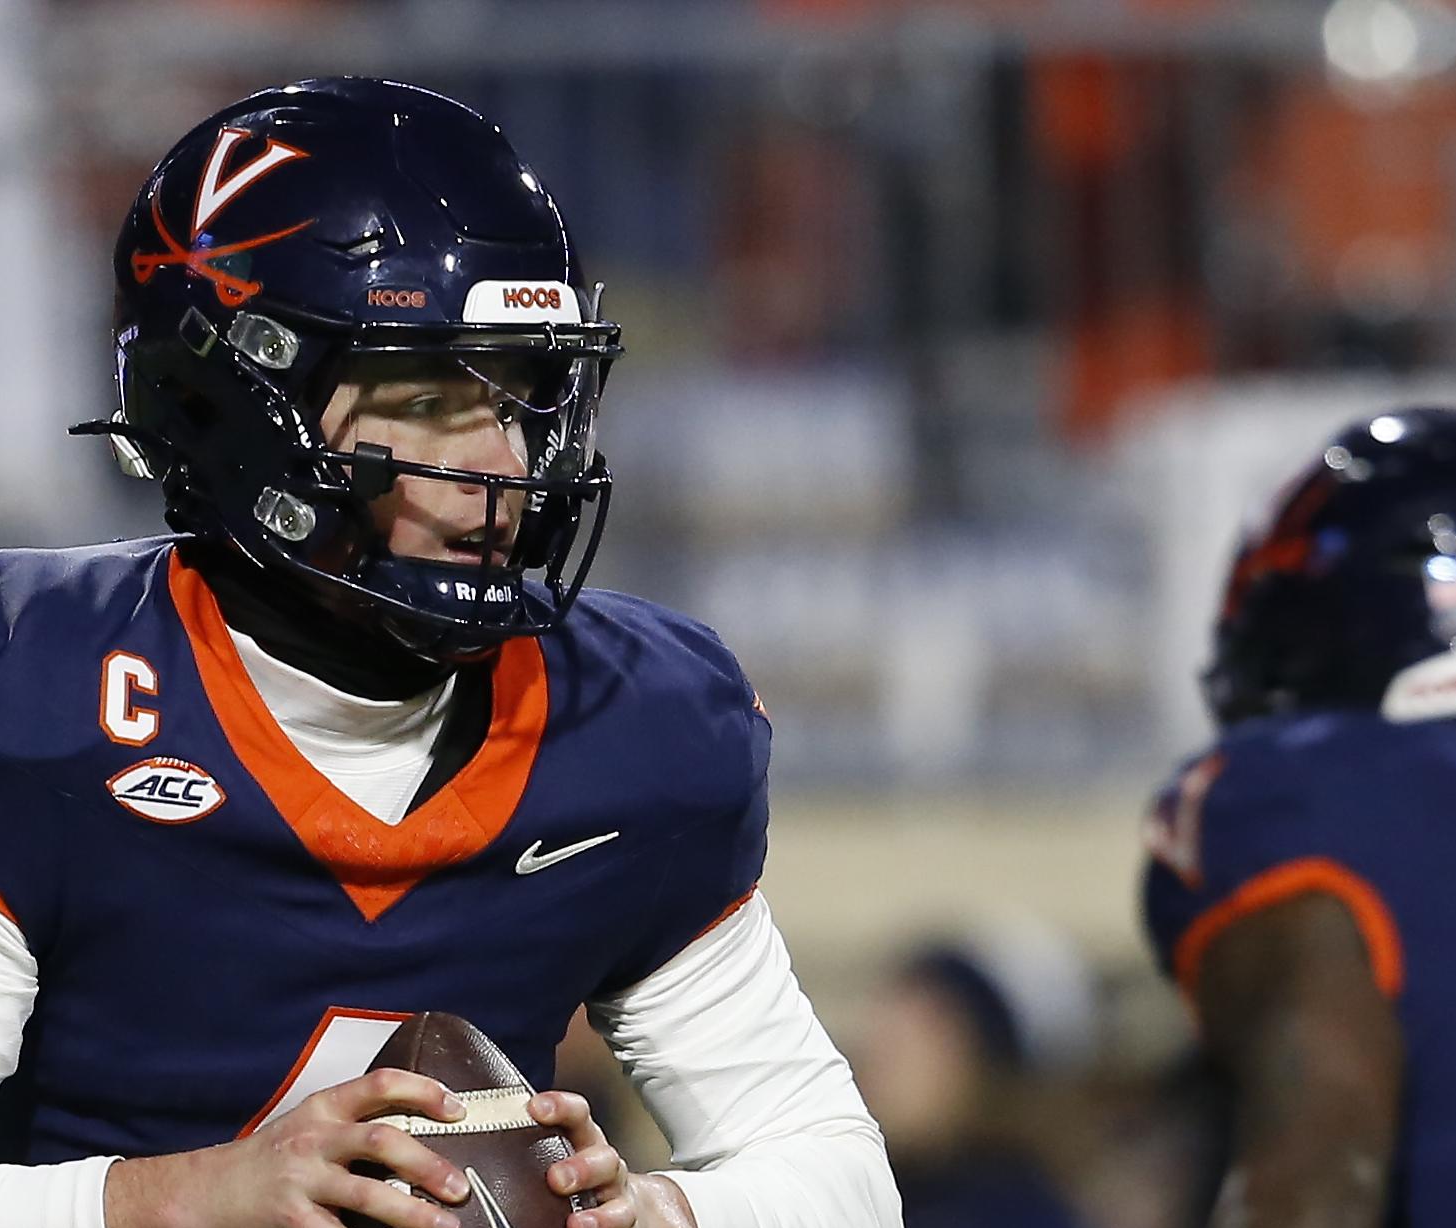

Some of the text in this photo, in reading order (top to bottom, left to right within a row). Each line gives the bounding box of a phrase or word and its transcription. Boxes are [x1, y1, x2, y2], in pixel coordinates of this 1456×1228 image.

[190, 127, 311, 241] V
[367, 288, 427, 309] HOOS
[503, 286, 562, 309] HOOS
[454, 581, 512, 603] Ridell
[99, 650, 160, 748] C
[123, 774, 211, 802] ACC
